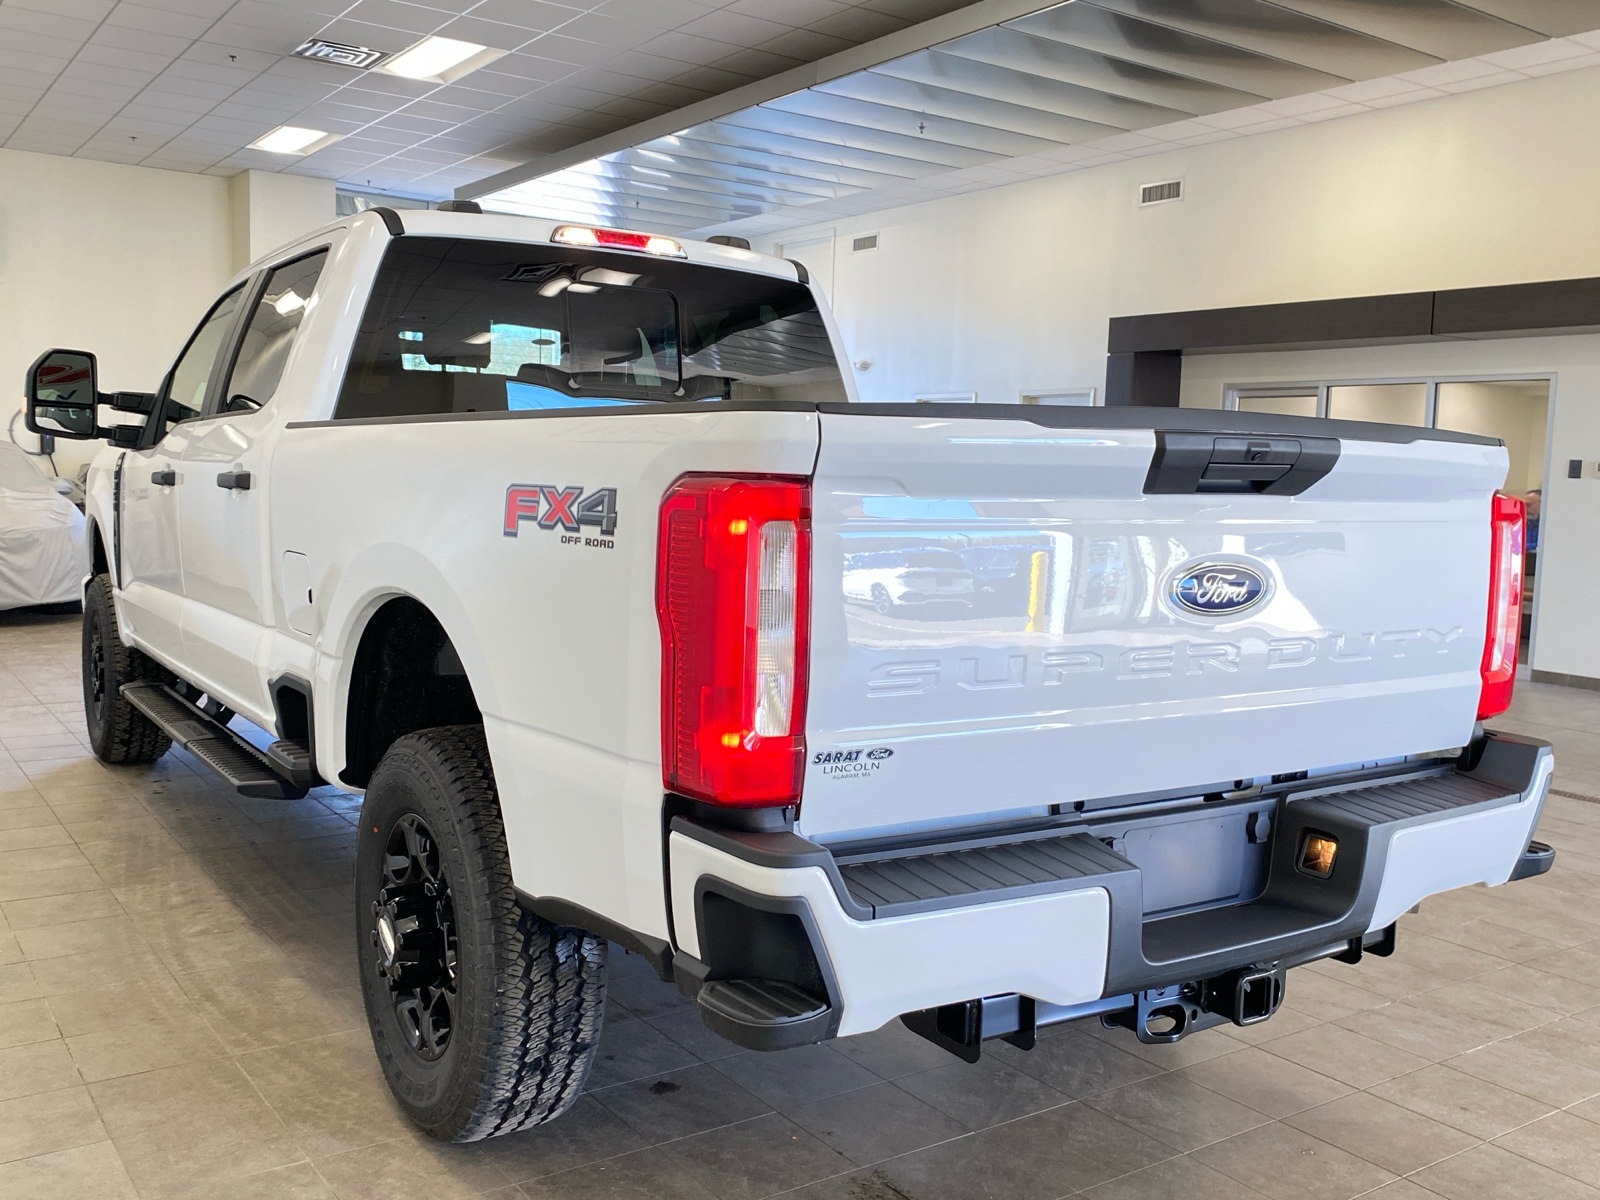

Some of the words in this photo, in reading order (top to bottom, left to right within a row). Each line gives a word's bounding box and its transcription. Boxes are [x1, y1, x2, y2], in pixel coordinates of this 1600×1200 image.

[503, 483, 618, 538] FX4
[560, 535, 581, 545] OFF
[585, 537, 615, 549] ROAD
[1196, 572, 1250, 604] Ford
[867, 641, 1241, 698] SUPER
[1267, 626, 1463, 670] DUTY
[812, 749, 864, 766] SARAT
[823, 762, 880, 774] LINCOLN
